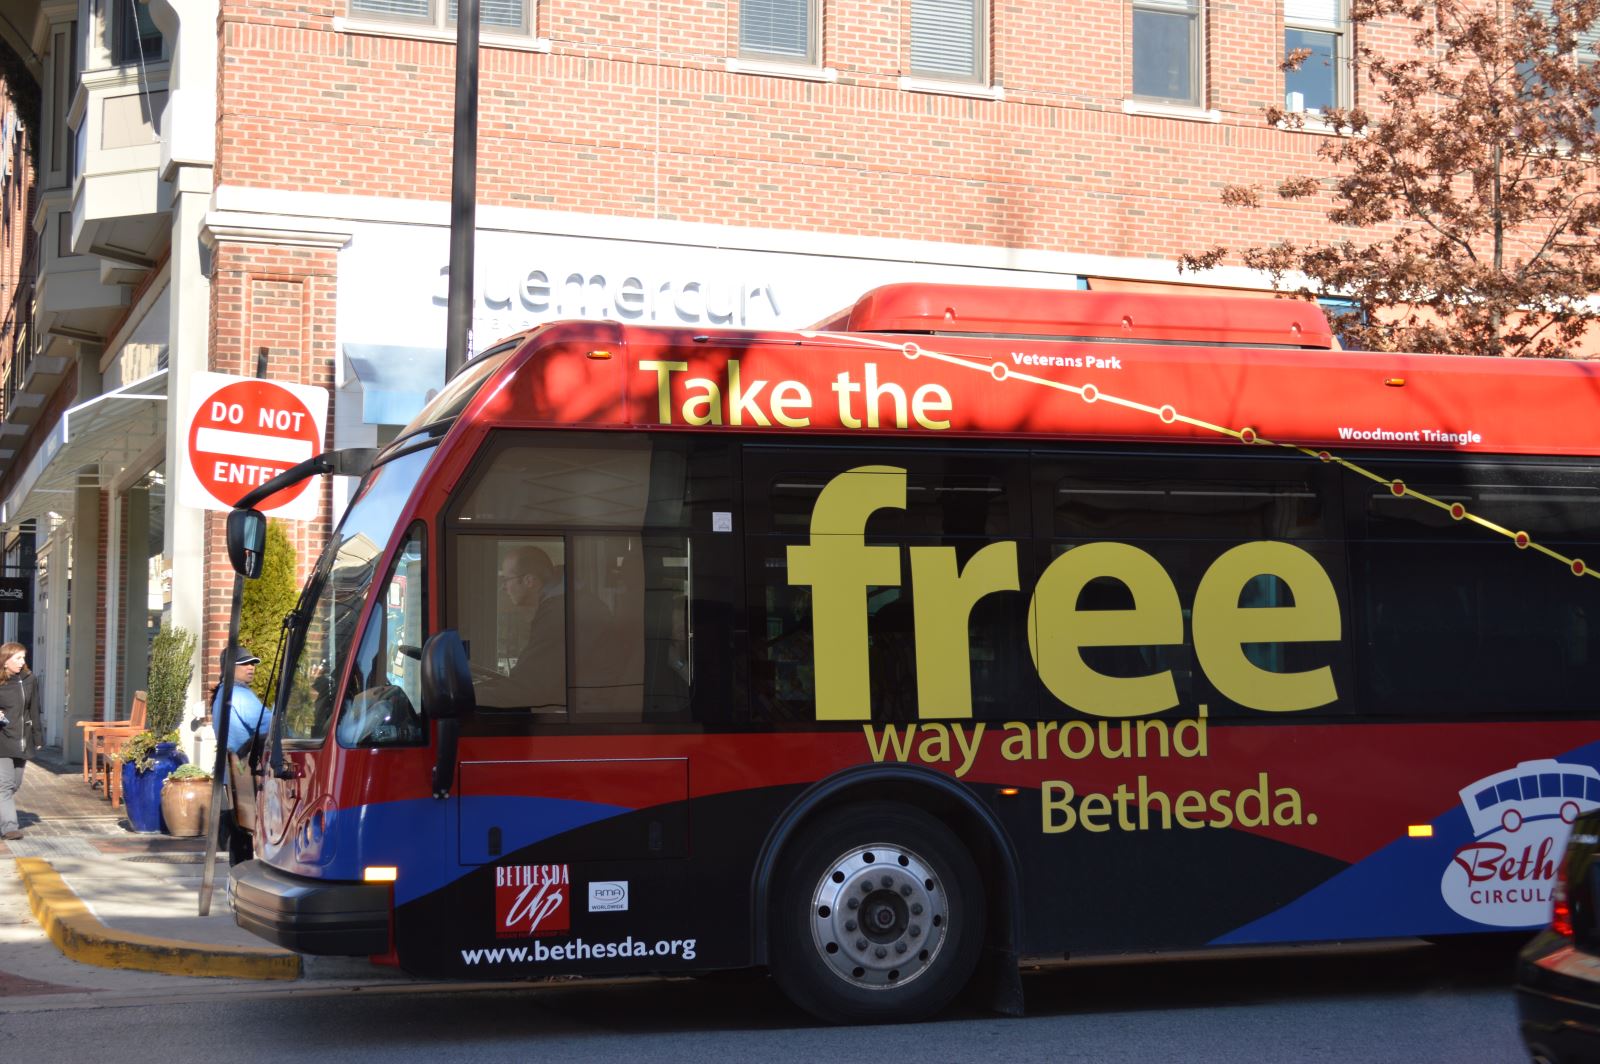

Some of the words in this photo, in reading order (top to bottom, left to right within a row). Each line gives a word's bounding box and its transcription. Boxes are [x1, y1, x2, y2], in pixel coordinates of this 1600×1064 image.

[1011, 352, 1083, 368] Veterans
[1085, 355, 1122, 369] Park
[638, 359, 813, 427] Take
[831, 362, 953, 430] the
[211, 401, 244, 425] DO
[258, 407, 305, 432] NOT
[1338, 427, 1419, 441] Woodmont
[1421, 429, 1482, 445] Triangle
[213, 461, 287, 486] ENTE
[786, 465, 1342, 721] free
[864, 721, 986, 778] way
[1000, 704, 1208, 761] around
[1041, 772, 1319, 834] Bethesda.
[496, 864, 569, 887] BETHESDA
[1454, 836, 1559, 888] Beth
[505, 879, 563, 935] Up
[461, 935, 697, 965] www.bethesda.org
